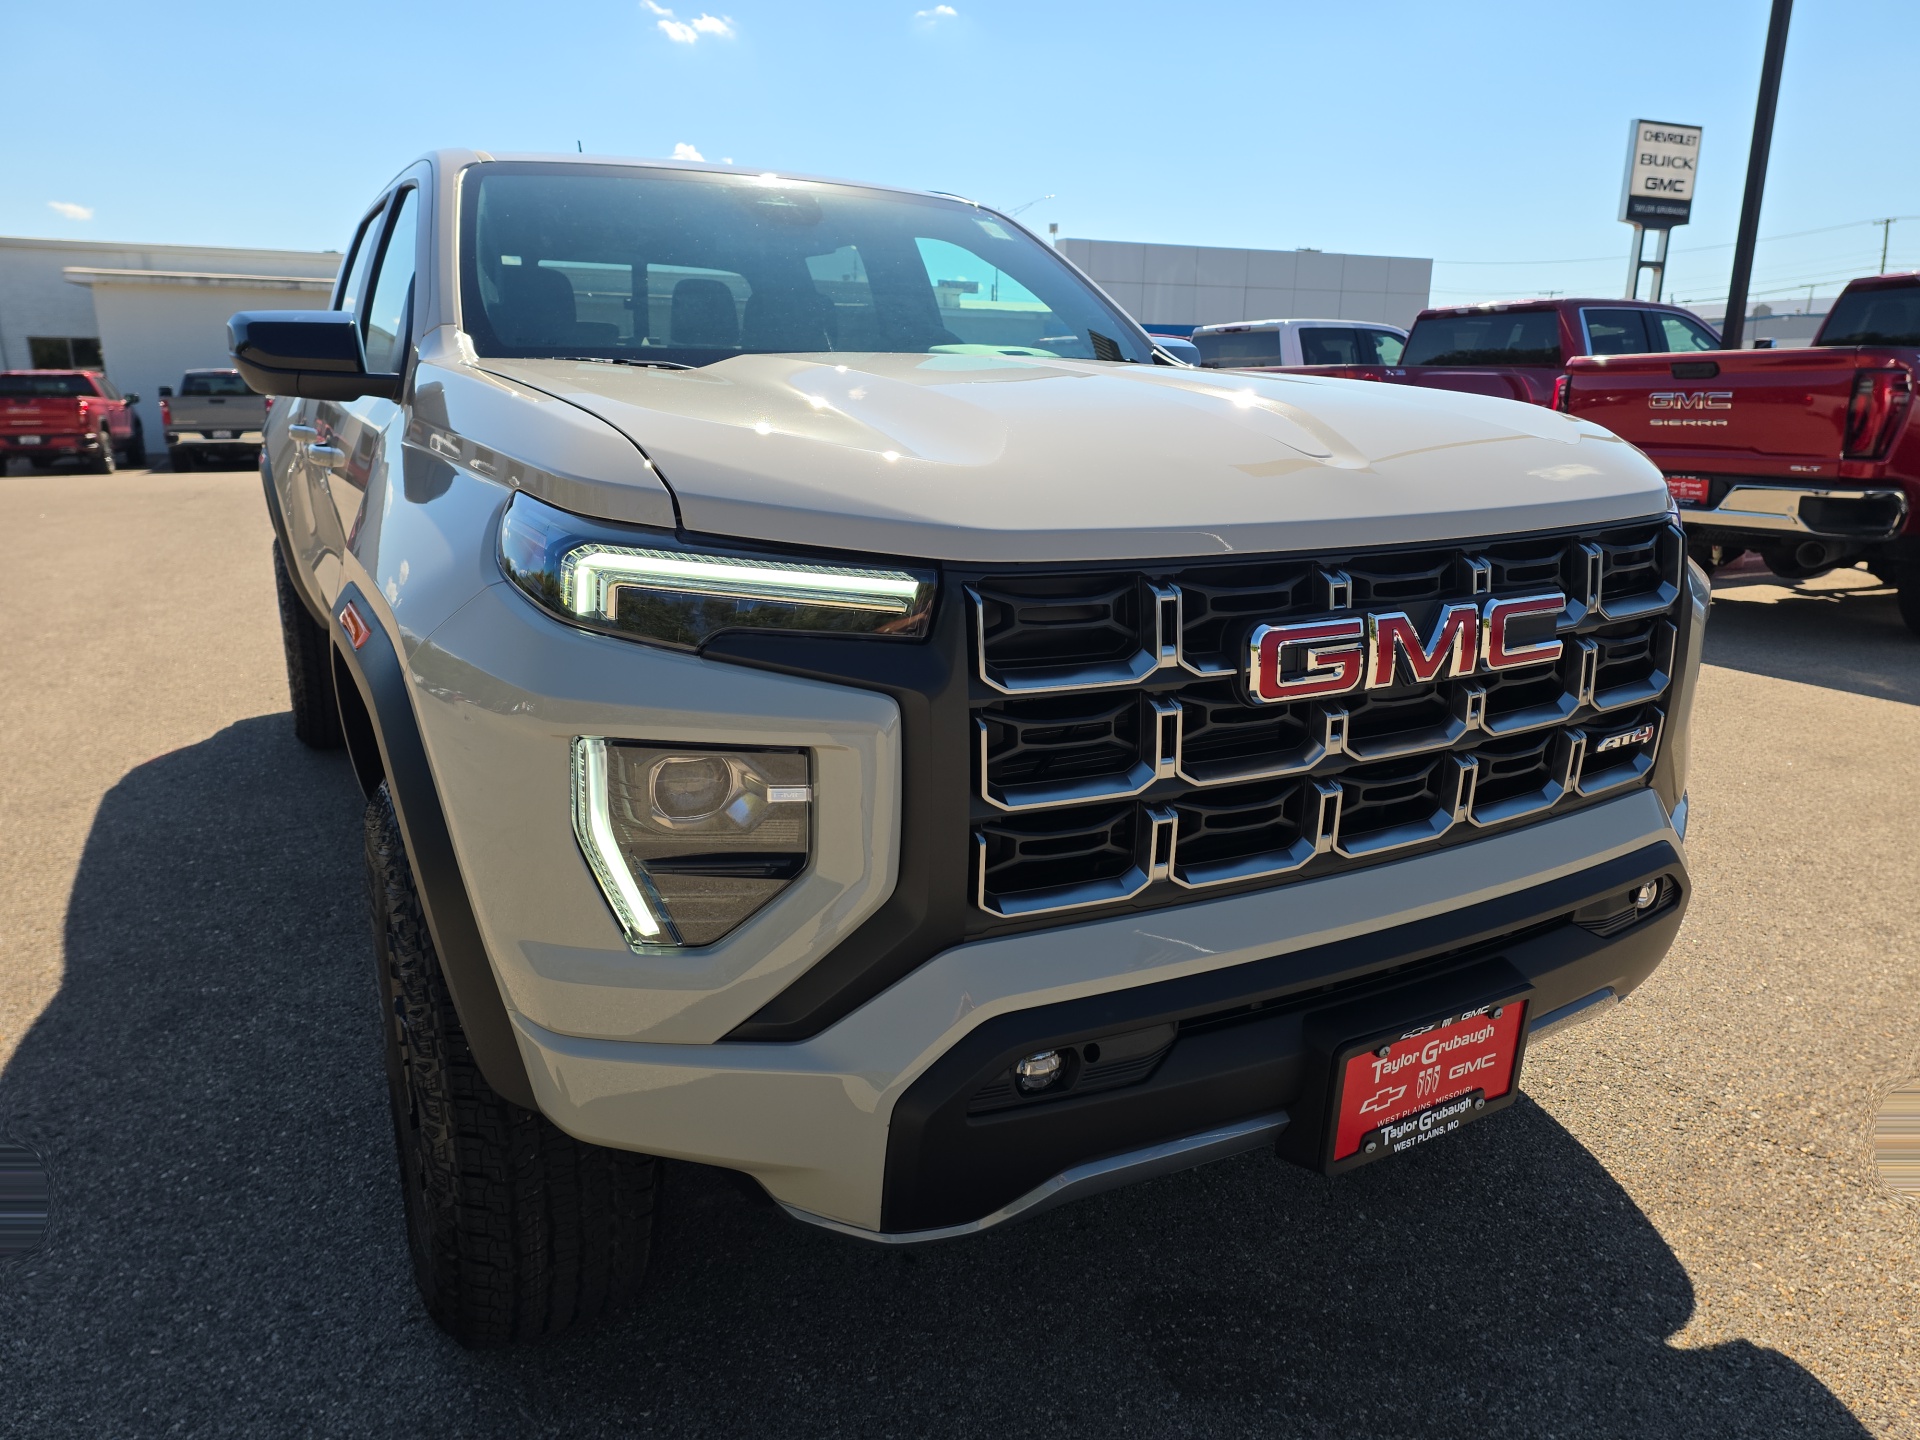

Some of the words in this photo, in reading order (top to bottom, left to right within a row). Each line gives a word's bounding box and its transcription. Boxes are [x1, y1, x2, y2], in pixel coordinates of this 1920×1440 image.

[1643, 130, 1697, 146] CHEVROLET
[1640, 153, 1694, 170] BUICK
[1645, 177, 1685, 192] GMC
[1648, 391, 1733, 410] GMC
[1248, 591, 1566, 704] GMC
[1596, 724, 1654, 752] AT4
[1460, 1004, 1490, 1021] GMC
[1371, 1051, 1420, 1084] Taylor
[1421, 1024, 1495, 1065] Grubaugh
[1448, 1052, 1497, 1080] GMC
[1377, 1112, 1401, 1128] WEST
[1435, 1085, 1473, 1105] MISSOURI
[1380, 1120, 1418, 1146] Taylor
[1418, 1097, 1472, 1131] Grubaugh
[1393, 1137, 1416, 1153] WEST
[1417, 1125, 1446, 1144] PLAINS,
[1447, 1119, 1459, 1132] MO
